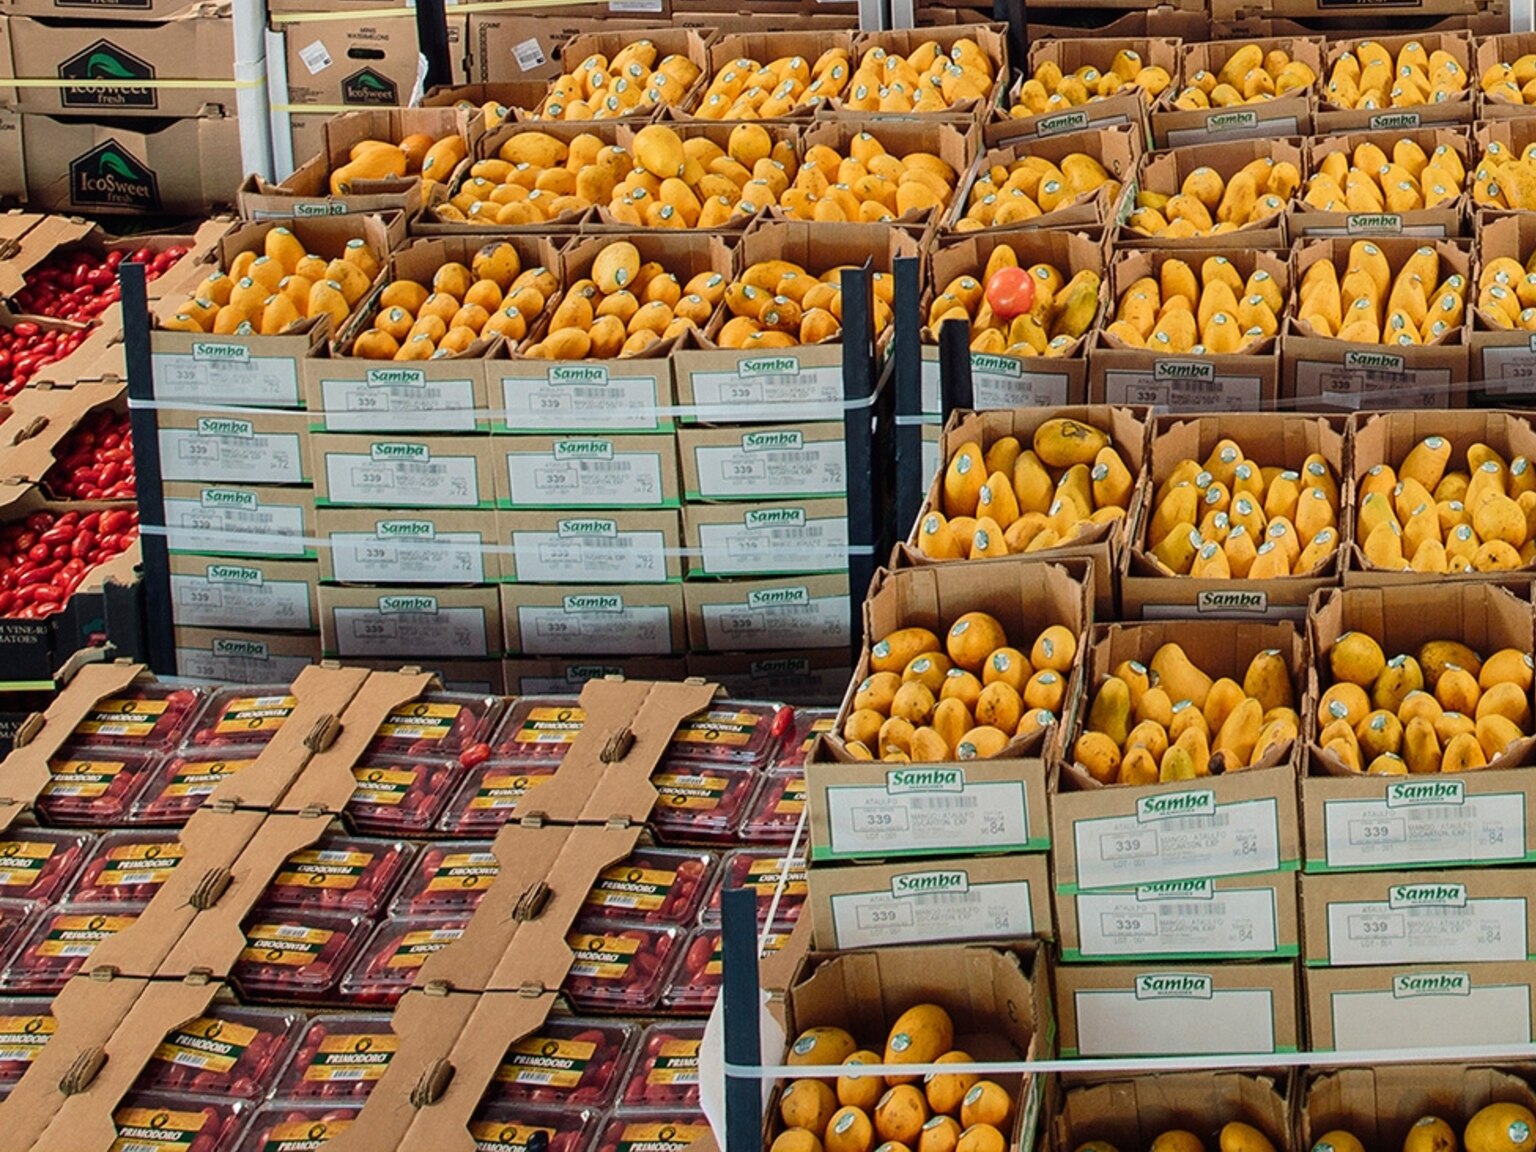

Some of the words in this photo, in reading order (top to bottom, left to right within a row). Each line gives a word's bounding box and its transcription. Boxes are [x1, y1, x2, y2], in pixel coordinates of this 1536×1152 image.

[1210, 114, 1253, 125] Samba
[1375, 115, 1416, 127] Samba
[81, 175, 150, 199] IcoSweet
[1351, 216, 1397, 228] Samba
[197, 346, 244, 357] Samba
[743, 359, 794, 372] Samba
[1158, 363, 1209, 376] Samba
[371, 371, 419, 383] Samba
[553, 368, 602, 380] Samba
[202, 419, 249, 433] Samba
[747, 433, 797, 446] Samba
[375, 445, 424, 457] Samba
[558, 442, 607, 453] Samba
[211, 567, 258, 580] Samba
[568, 596, 617, 608] Samba
[753, 589, 803, 602] Samba
[1202, 593, 1262, 607] Samba
[384, 597, 432, 609] Samba
[893, 770, 956, 786] Samba
[1393, 783, 1458, 799] Samba
[1143, 794, 1209, 813] Samba
[866, 814, 892, 826] 339
[1363, 826, 1388, 838] 339
[1115, 840, 1140, 852] 339
[898, 873, 961, 890] Samba
[1395, 887, 1461, 903] Samba
[872, 910, 896, 922] 339
[1141, 975, 1206, 992] Samba
[1399, 975, 1463, 991] Samba
[175, 1035, 232, 1054] PRIMODORO
[326, 1053, 386, 1064] PRIMODORO
[514, 1054, 573, 1068] PRIMODORO
[120, 1127, 182, 1142] PRIMODORO
